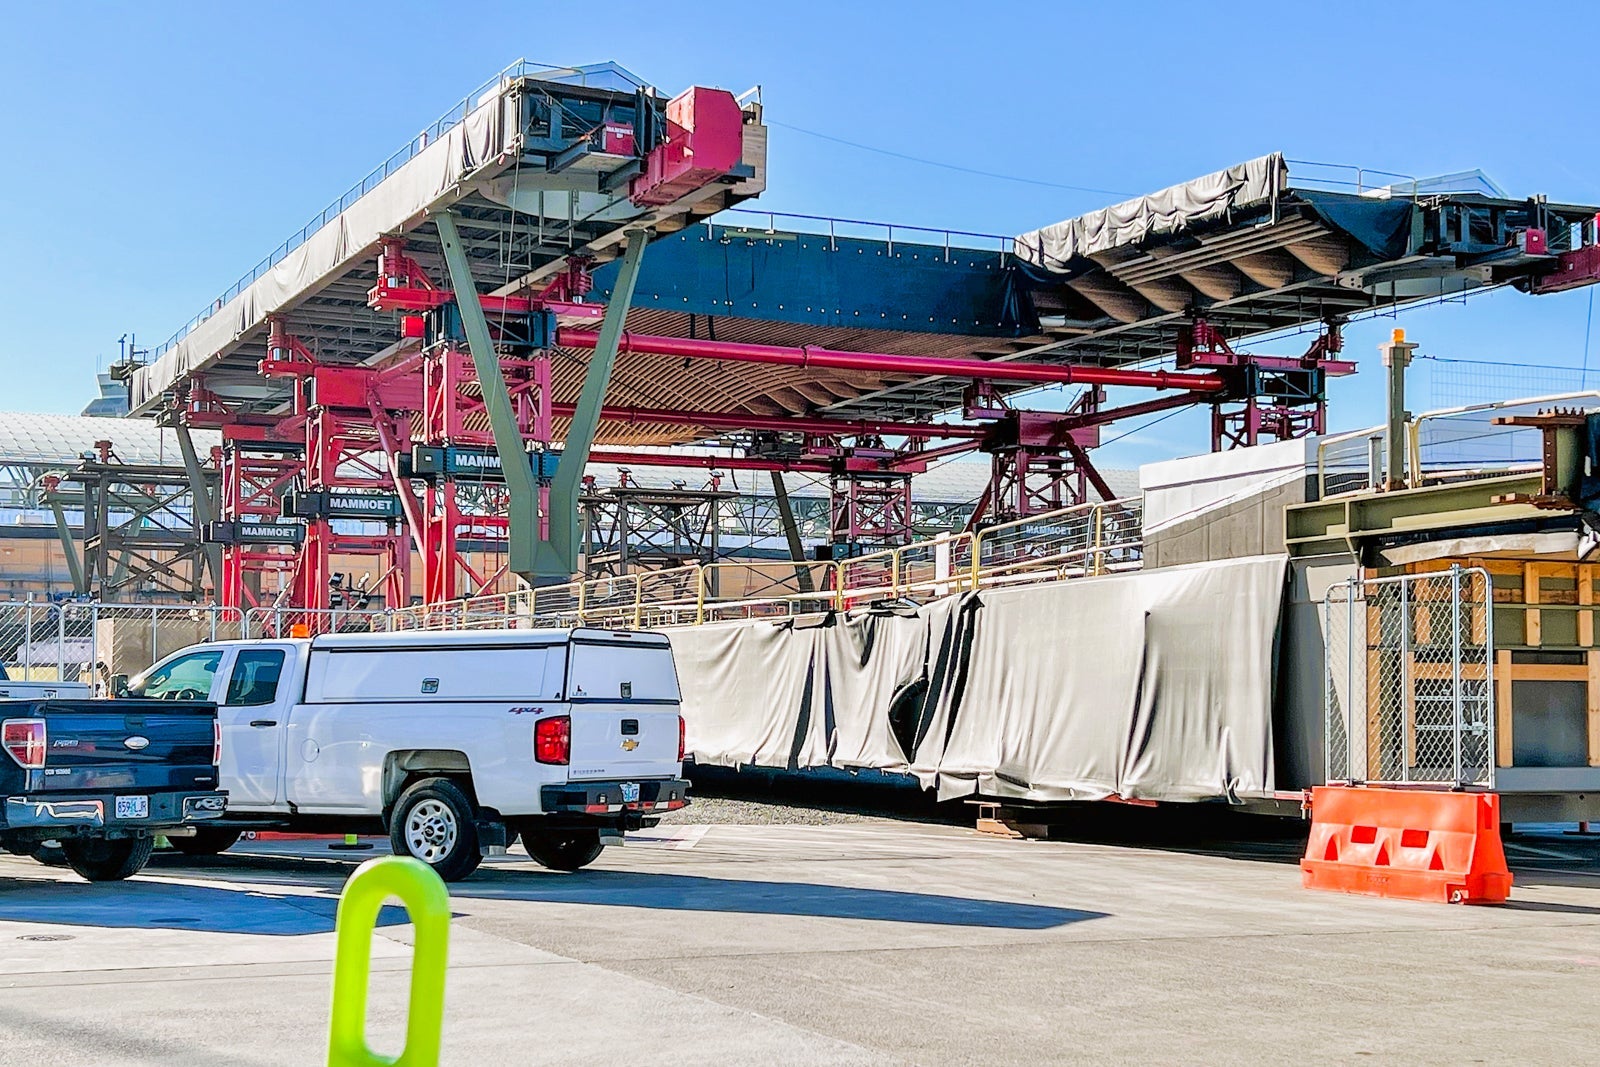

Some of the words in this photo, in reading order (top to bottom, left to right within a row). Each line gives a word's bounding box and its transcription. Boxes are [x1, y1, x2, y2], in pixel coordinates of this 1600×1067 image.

[455, 454, 501, 468] MAMM
[330, 498, 393, 510] MAMMOET
[241, 527, 296, 537] MAMMOET
[1026, 525, 1072, 535] MAMMOET
